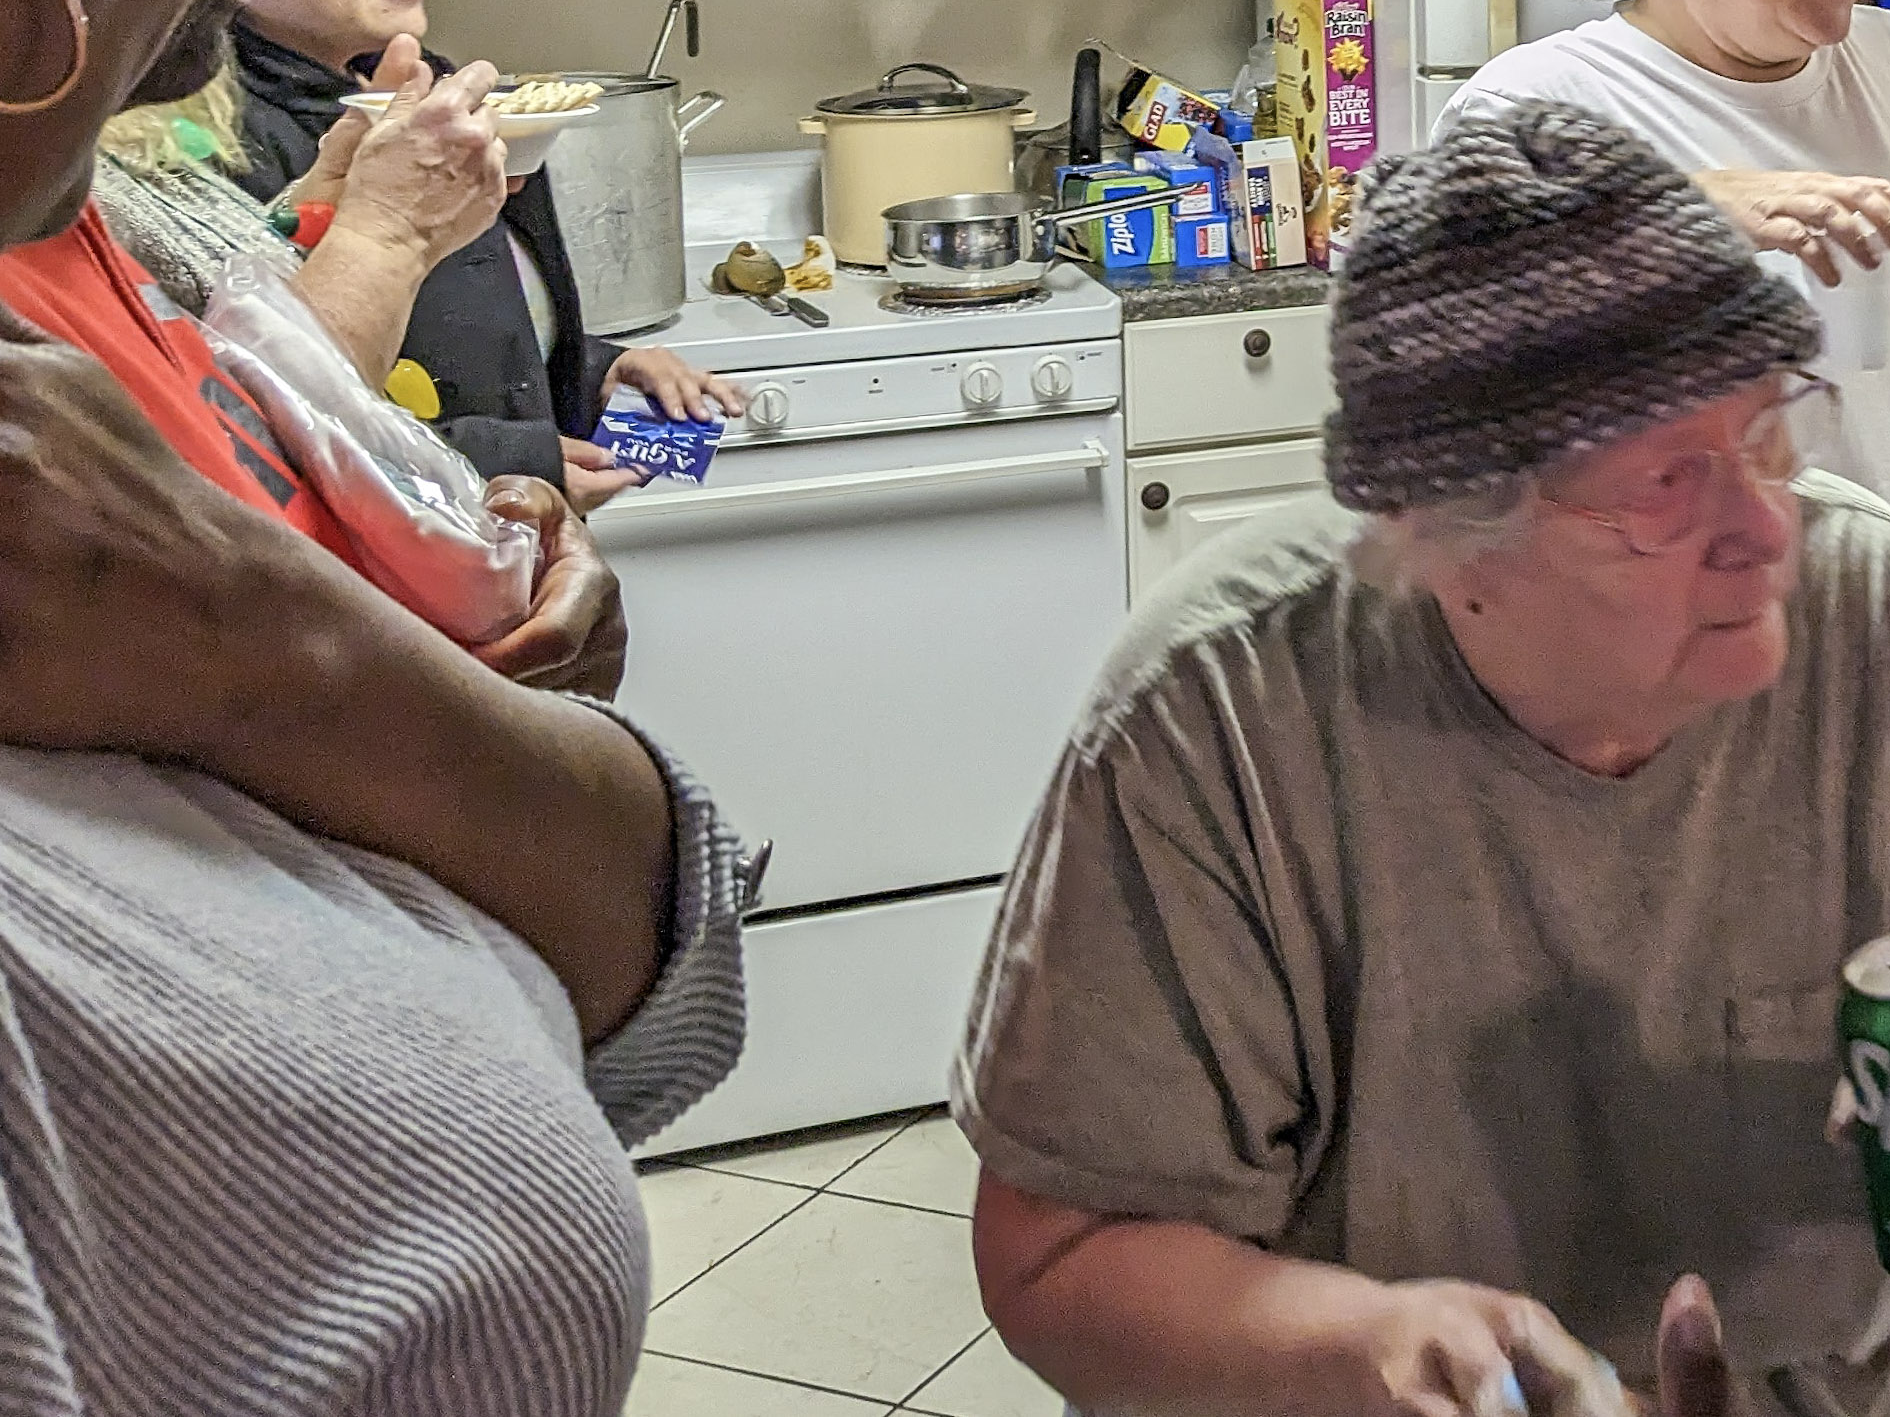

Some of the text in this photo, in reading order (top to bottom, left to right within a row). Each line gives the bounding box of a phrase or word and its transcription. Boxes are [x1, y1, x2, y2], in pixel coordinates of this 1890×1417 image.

[1327, 11, 1366, 24] Raisin
[1331, 23, 1363, 36] Bran
[1329, 89, 1369, 99] BEST IN
[1329, 98, 1370, 111] EVERY
[1143, 104, 1165, 140] GLAD
[1329, 109, 1371, 126] BITE
[1108, 213, 1136, 255] Ziplo
